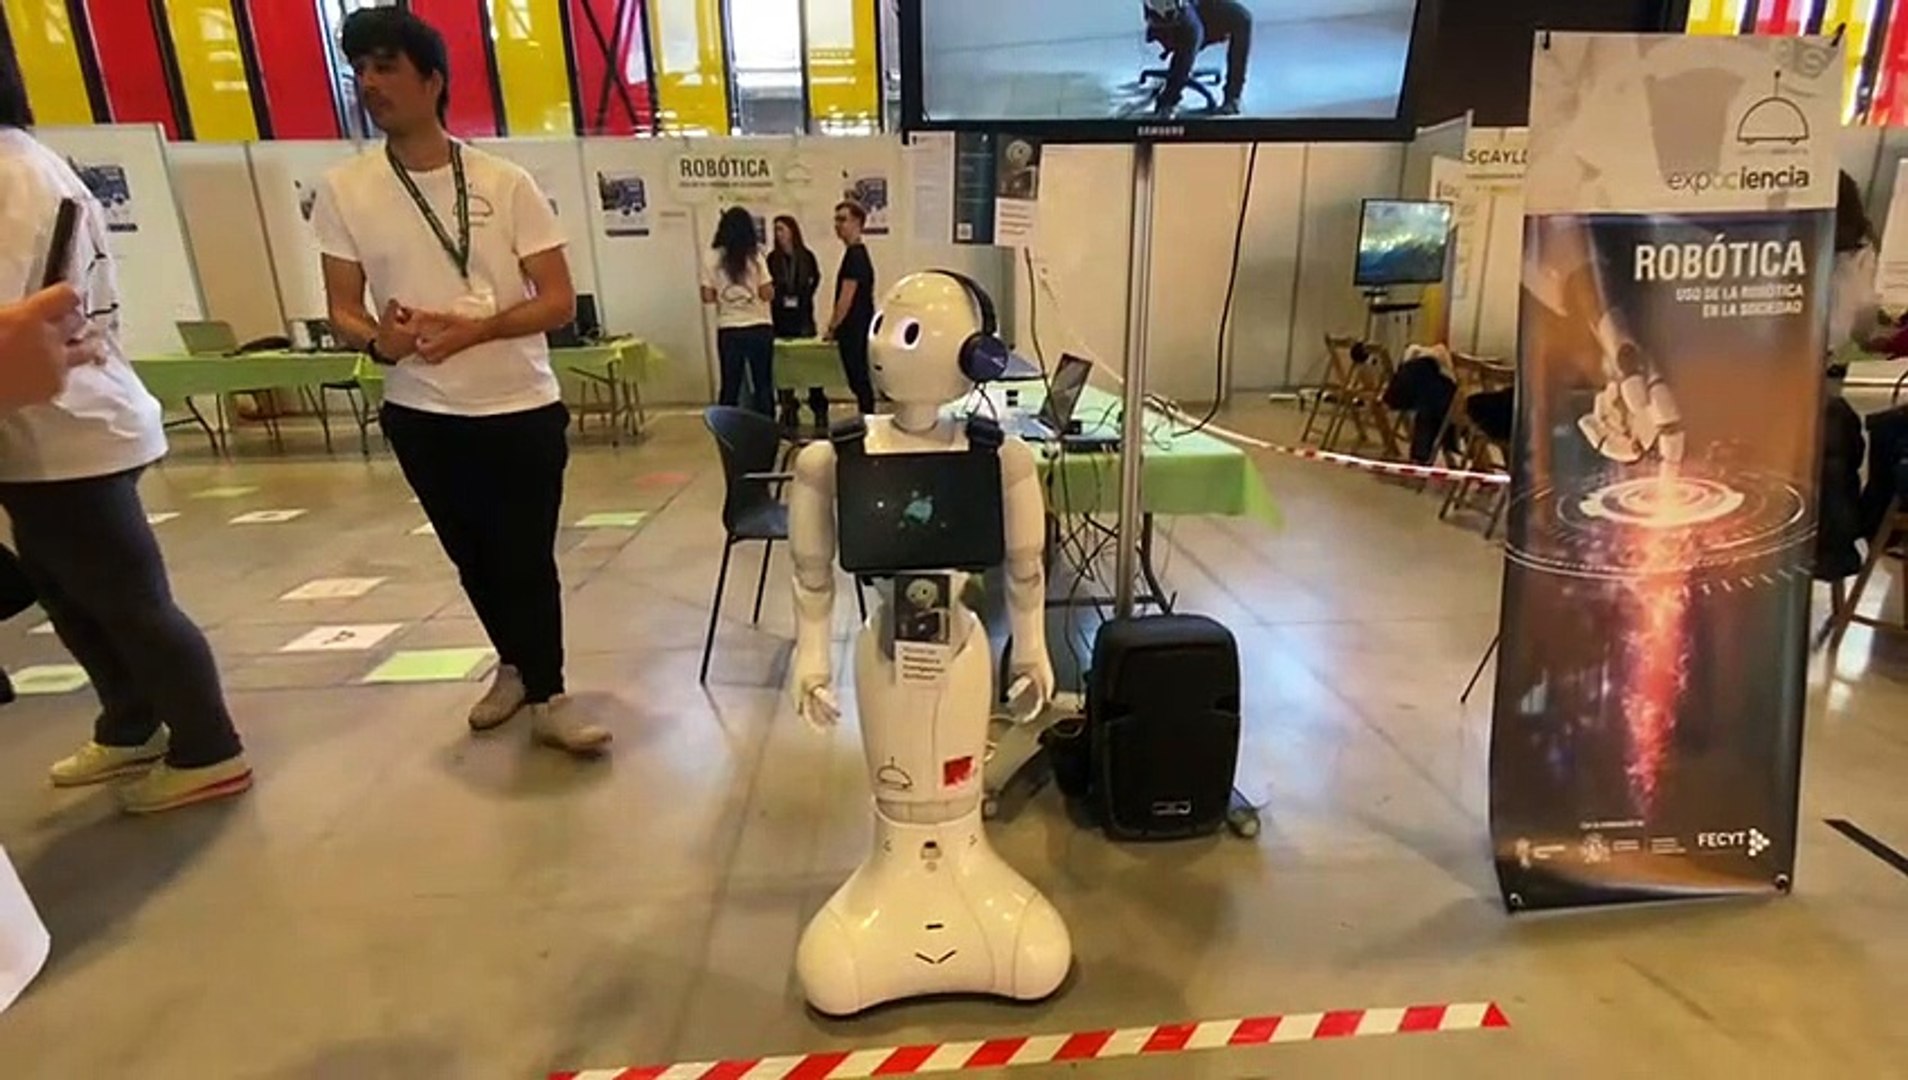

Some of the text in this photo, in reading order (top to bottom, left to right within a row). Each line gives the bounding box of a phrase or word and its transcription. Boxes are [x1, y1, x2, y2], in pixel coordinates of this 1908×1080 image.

[680, 154, 770, 178] ROBÓTICA
[1667, 166, 1810, 194] expociencia
[1634, 233, 1806, 281] ROBÓTICA
[1703, 287, 1719, 300] DE
[1722, 286, 1738, 300] LA
[1721, 303, 1737, 317] LA
[1698, 832, 1746, 848] FECYT
